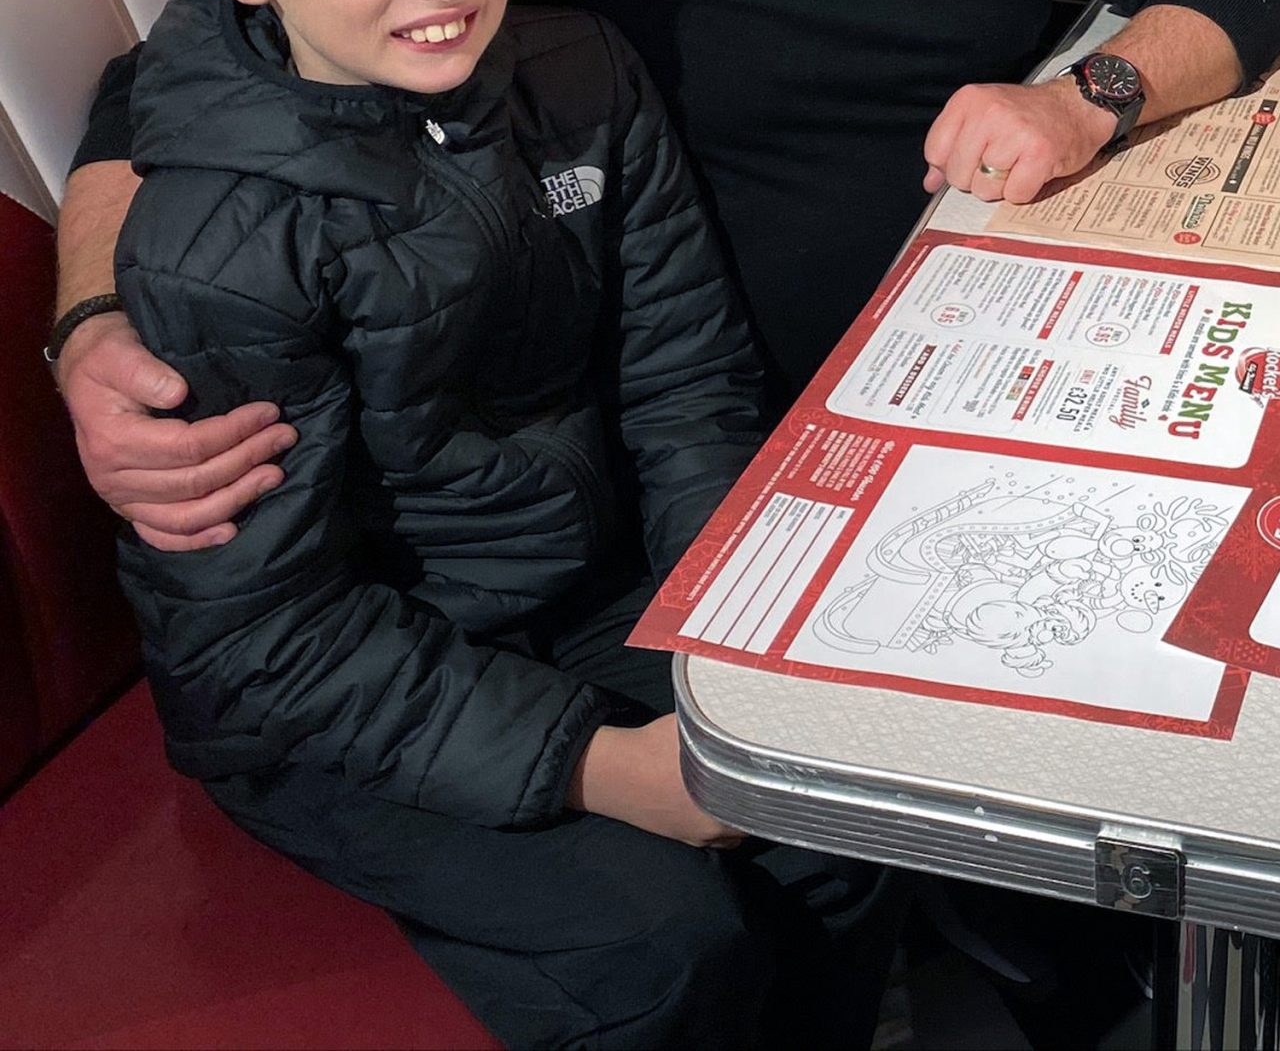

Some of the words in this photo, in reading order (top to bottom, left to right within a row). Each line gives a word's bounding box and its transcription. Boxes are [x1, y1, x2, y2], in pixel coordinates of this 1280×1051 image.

[540, 169, 577, 191] THE
[1174, 155, 1210, 188] WINGS
[545, 181, 582, 204] RTH
[552, 194, 587, 218] ACE
[1194, 322, 1204, 335] meals
[1201, 301, 1253, 359] KIDS
[1164, 331, 1177, 347] MEALS
[1191, 335, 1199, 343] are
[916, 351, 929, 365] ADD
[1184, 344, 1195, 358] served
[1102, 364, 1111, 374] TWO
[1180, 359, 1189, 368] with
[896, 371, 916, 397] DESSERT
[1031, 366, 1047, 388] CHOOSE
[1093, 376, 1104, 392] LITTLE
[1103, 378, 1113, 389] TWO
[1095, 390, 1106, 407] ADULT
[1108, 374, 1152, 430] Family
[1167, 388, 1179, 399] Kids
[1167, 363, 1229, 440] MENU
[1016, 397, 1031, 414] DRINK
[1056, 387, 1087, 420] €32.50
[1083, 393, 1096, 412] HELPER
[1161, 399, 1173, 411] drink
[1073, 414, 1086, 431] MEALS
